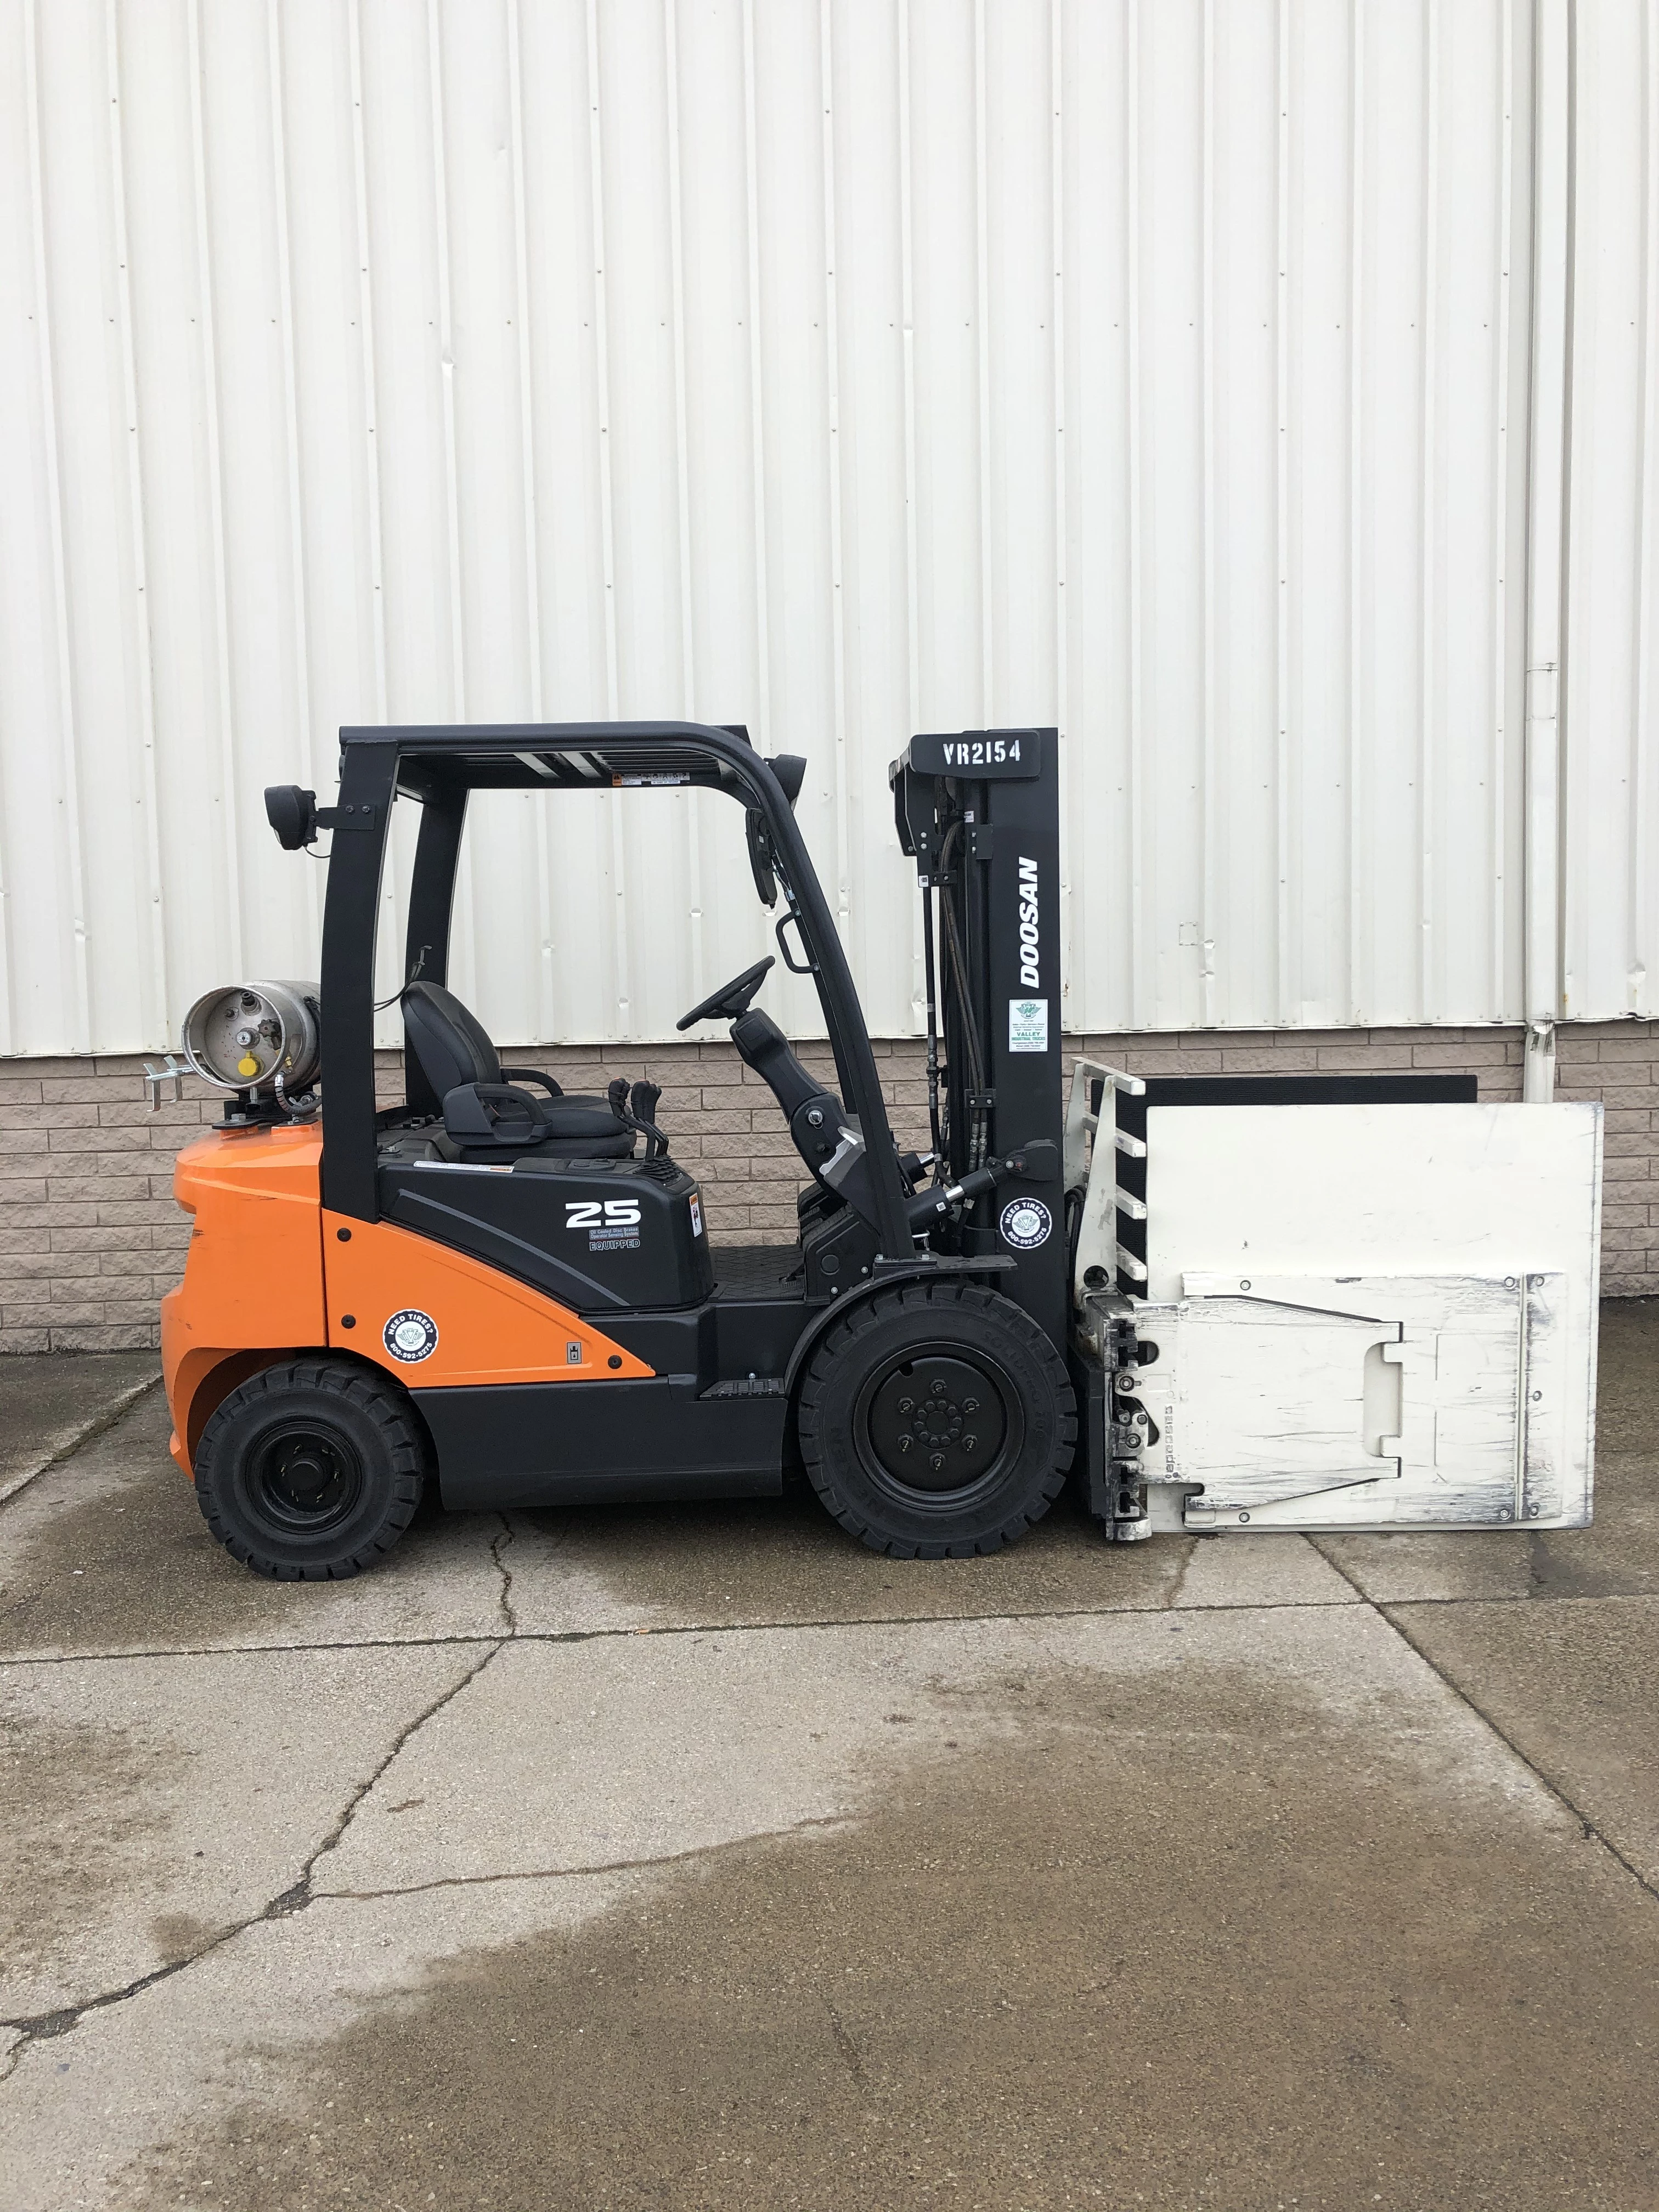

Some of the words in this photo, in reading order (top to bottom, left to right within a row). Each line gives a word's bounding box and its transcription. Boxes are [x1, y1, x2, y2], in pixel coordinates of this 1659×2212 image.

[943, 740, 1021, 765] VR2154
[1019, 856, 1040, 989] DOOSAN
[565, 1199, 642, 1228] 25
[1005, 1205, 1020, 1224] NEED
[1022, 1202, 1047, 1219] TIRES?
[589, 1239, 641, 1251] EQUIPPED
[387, 1314, 406, 1335] NEED
[408, 1313, 433, 1334] TIRES?
